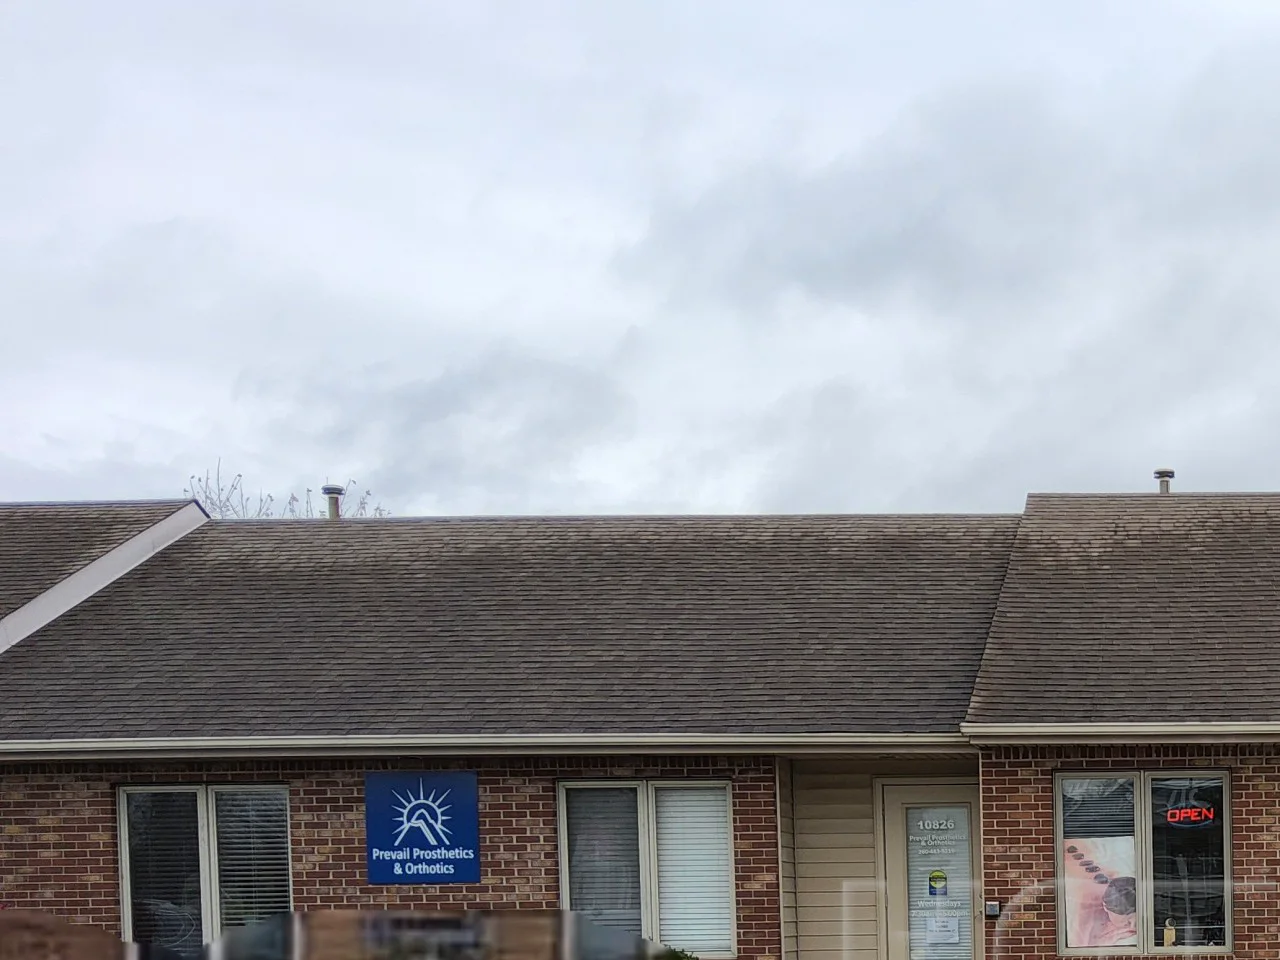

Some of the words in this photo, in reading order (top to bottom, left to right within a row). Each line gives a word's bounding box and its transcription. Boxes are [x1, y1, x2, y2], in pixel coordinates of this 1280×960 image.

[1167, 807, 1214, 822] OPEN
[917, 820, 955, 830] 10826
[372, 847, 410, 860] Prevail
[413, 847, 474, 860] Prosthetics
[393, 862, 403, 875] &
[405, 862, 455, 875] Orthotics
[917, 900, 962, 908] Wednesdays
